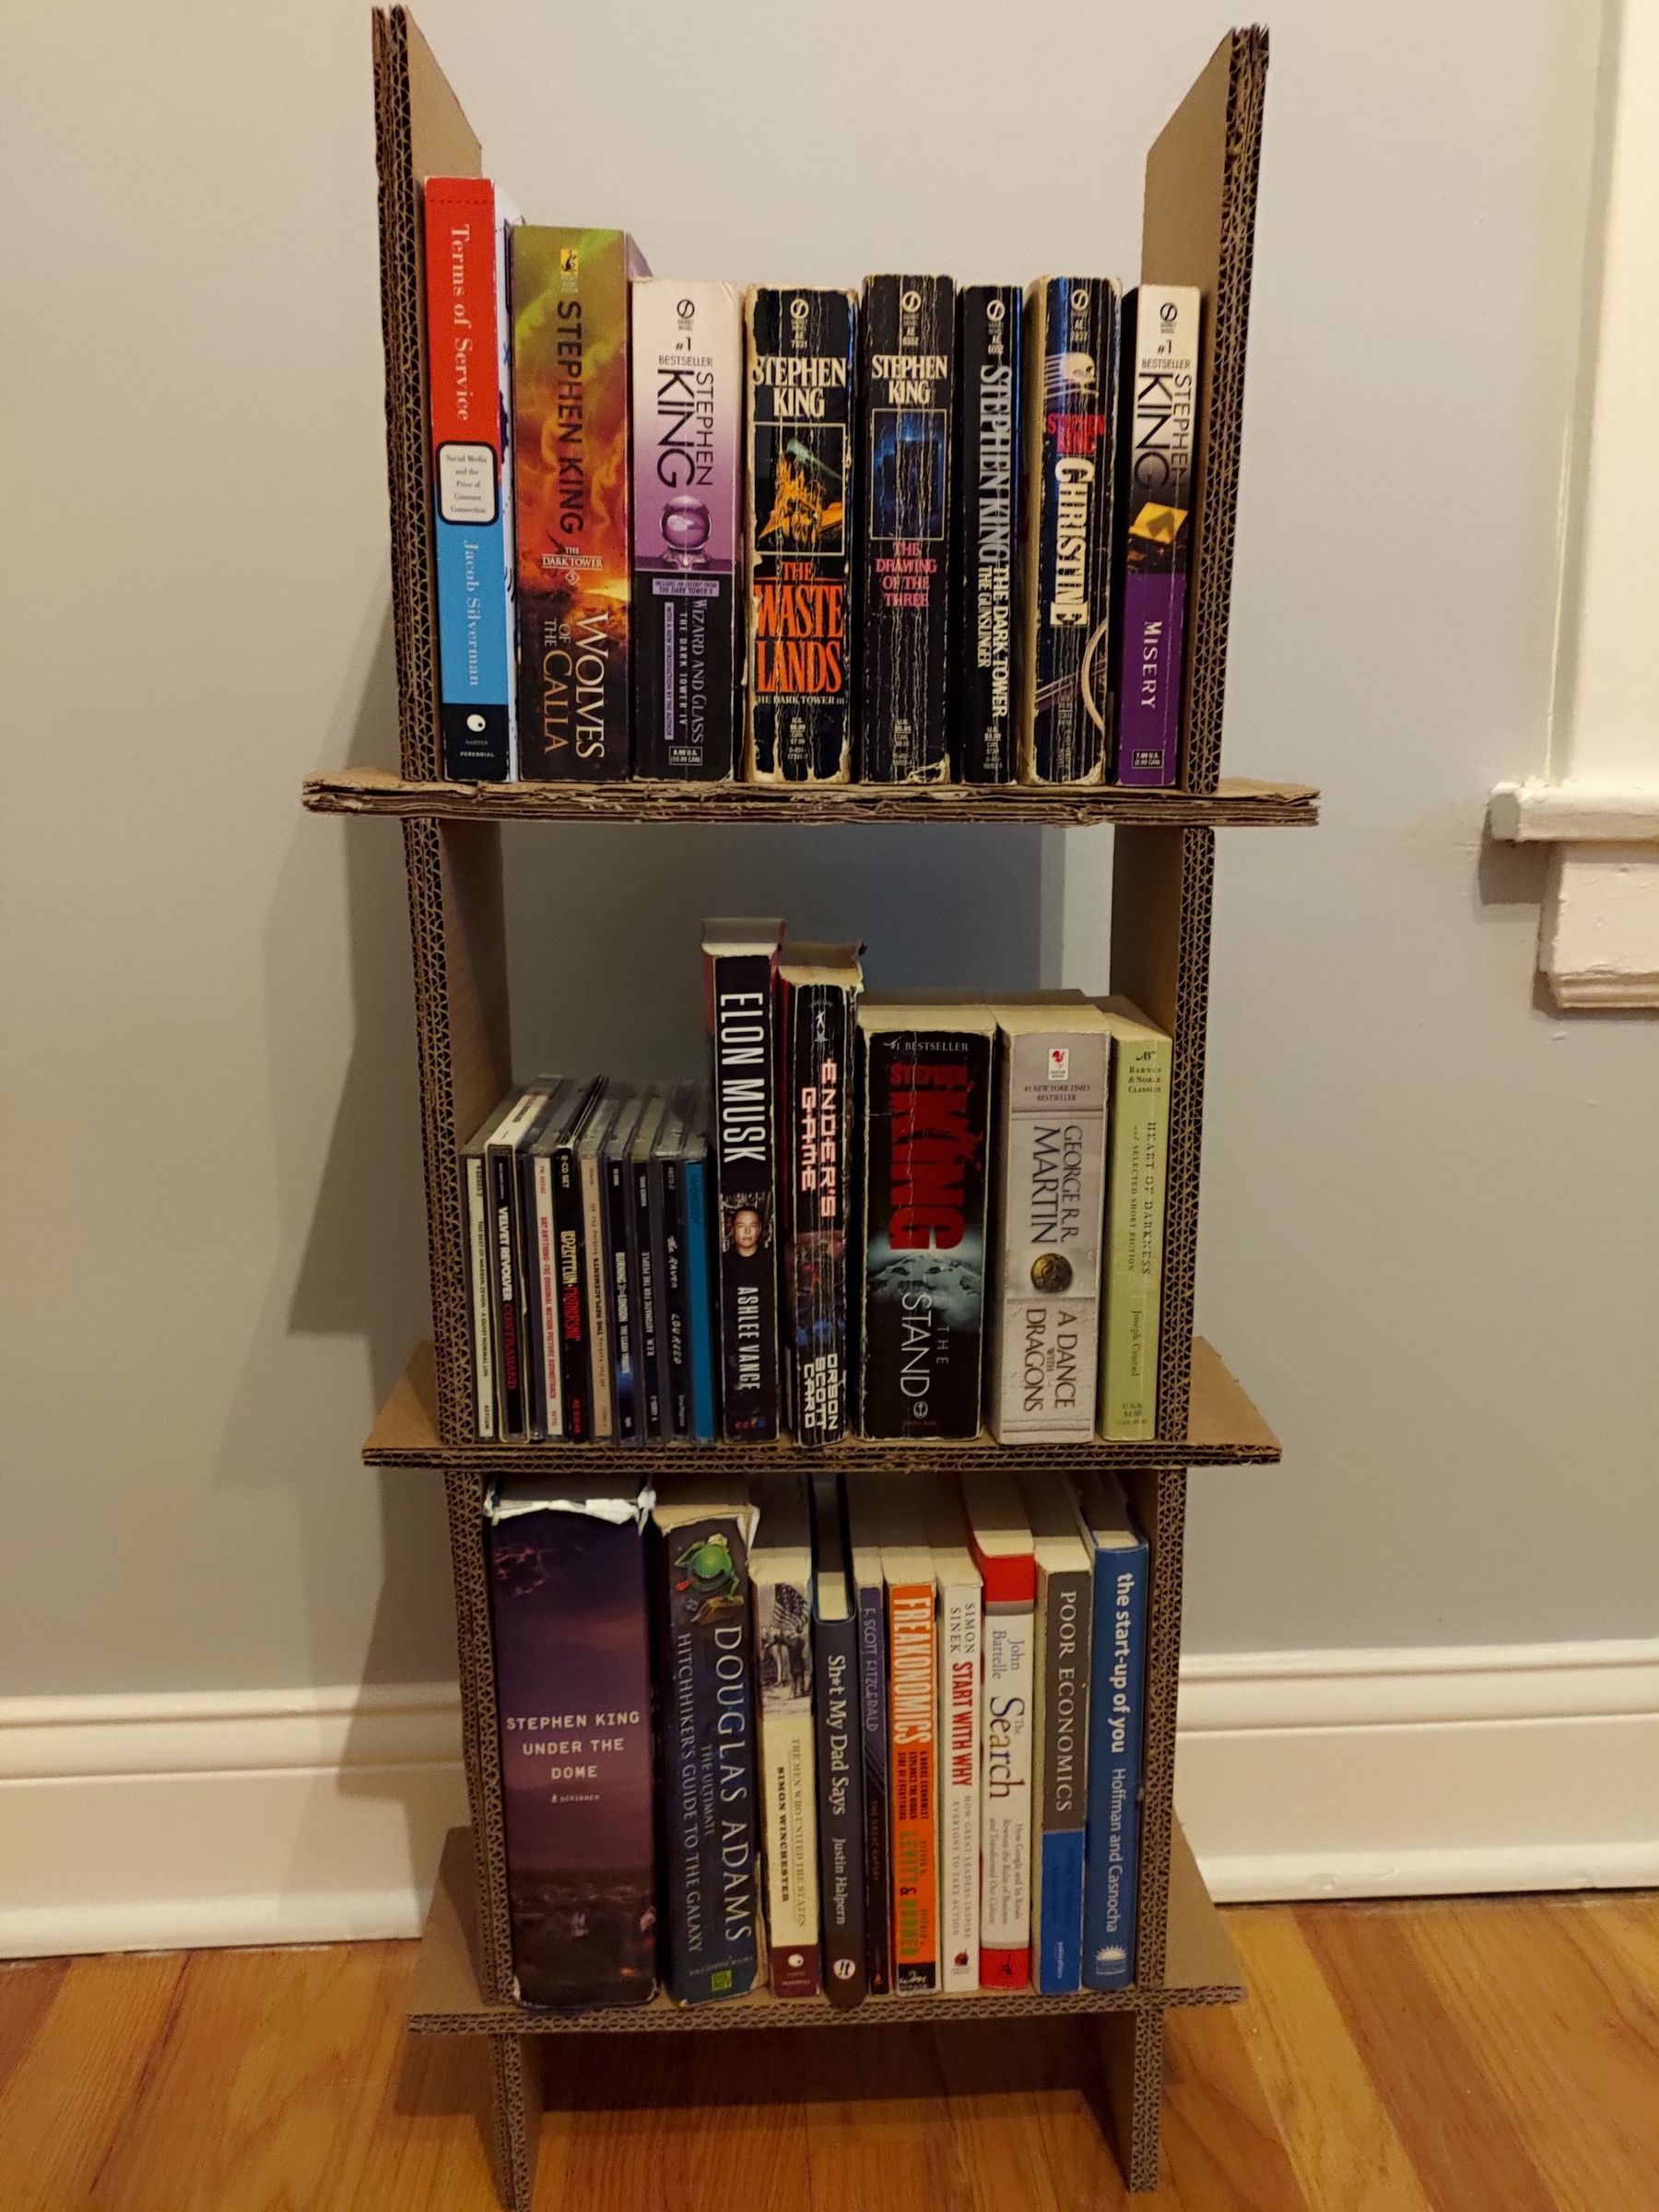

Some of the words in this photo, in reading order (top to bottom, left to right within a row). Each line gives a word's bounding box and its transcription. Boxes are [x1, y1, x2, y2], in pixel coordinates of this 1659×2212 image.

[451, 223, 470, 296] Terms
[453, 303, 472, 330] of
[658, 355, 713, 367] BESTSELLER
[676, 337, 691, 352] #1
[871, 354, 948, 380] STEPHEN
[1141, 359, 1191, 369] BESTSELLER
[1157, 339, 1171, 355] #1
[454, 337, 474, 420] Service
[557, 300, 583, 444] STEPHEN
[754, 356, 847, 388] STEPHEN
[888, 379, 931, 406] KING
[773, 387, 826, 418] KING
[656, 369, 695, 488] KING
[696, 371, 713, 486] STEPHEN
[978, 365, 1013, 491] STEPHEN
[1134, 371, 1173, 490] KING
[1171, 373, 1193, 488] STEPHEN
[559, 456, 583, 535] KING
[565, 547, 580, 555] THE
[893, 542, 922, 556] THE
[978, 495, 1011, 565] KING
[1050, 456, 1095, 628] CHRISTINE
[464, 539, 479, 592] Jacob
[542, 556, 569, 567] DARK
[569, 556, 603, 569] TOWER
[782, 561, 812, 581] THE
[875, 558, 937, 573] DRAWING
[882, 575, 900, 590] OF
[903, 575, 930, 590] THE
[978, 566, 993, 597] THE
[993, 565, 1010, 601] THE
[679, 613, 688, 633] THE
[754, 583, 845, 638] WASTE
[884, 593, 929, 607] THREE
[465, 597, 481, 687] Silverman
[544, 618, 558, 648] THE
[558, 623, 571, 644] OF
[691, 598, 707, 655] WIZARD
[977, 599, 993, 669] GUNSLINGER
[993, 605, 1009, 655] DARK
[679, 638, 688, 667] DARK
[756, 641, 842, 693] LANDS
[1140, 621, 1162, 709] MISERY
[575, 613, 608, 759] WOLVES
[679, 673, 688, 712] TOWER
[691, 664, 705, 690] AND
[992, 657, 1008, 718] TOWER
[543, 651, 573, 755] CALLA
[691, 695, 708, 744] GLASS
[720, 993, 765, 1065] ELON
[905, 1041, 969, 1052] BESTSELLER
[890, 1063, 967, 1085] STEPHEN
[1071, 1084, 1090, 1092] TIMES
[722, 1078, 766, 1163] MUSK
[801, 1087, 817, 1192] GAME
[820, 1058, 838, 1218] ENDER'S
[1062, 1124, 1083, 1202] GEORGE
[1146, 1122, 1157, 1169] HEART
[888, 1091, 968, 1250] KING
[1030, 1126, 1061, 1244] MARTIN
[1131, 1144, 1140, 1194] SELECTED
[498, 1206, 510, 1246] VELVET
[1129, 1198, 1137, 1230] SHORT
[1128, 1231, 1136, 1271] FICTION
[1141, 1201, 1154, 1275] DARKNESS
[499, 1246, 513, 1301] REVOLVER
[671, 1313, 682, 1335] LOU
[737, 1287, 759, 1339] ASHLEE
[1057, 1310, 1077, 1326] A
[1130, 1311, 1142, 1341] Joseph
[501, 1303, 517, 1390] CONTRABAND
[671, 1335, 682, 1365] REED
[900, 1292, 933, 1397] STAND
[935, 1325, 949, 1364] THE
[1023, 1309, 1046, 1412] DRAGONS
[1046, 1347, 1055, 1372] WITH
[1130, 1344, 1140, 1377] Conrad
[738, 1345, 760, 1391] VANCE
[1054, 1334, 1078, 1408] DANCE
[804, 1363, 816, 1429] CARD
[815, 1357, 827, 1430] SCOTT
[827, 1353, 839, 1430] ORSON
[1116, 1572, 1135, 1606] the
[863, 1619, 877, 1654] SCOTT
[949, 1606, 961, 1653] SINEK
[964, 1603, 975, 1653] SIMON
[1059, 1591, 1077, 1659] POOR
[893, 1597, 932, 1745] FREAKONOMICS
[1007, 1639, 1025, 1671] John
[1109, 1610, 1132, 1689] start-up
[677, 1633, 696, 1760] HITCHHIKER'S
[865, 1660, 878, 1732] FITZGERALD
[952, 1662, 972, 1707] START
[1112, 1696, 1131, 1712] of
[506, 1713, 587, 1730] STEPHEN
[595, 1711, 641, 1726] KING
[714, 1624, 747, 1803] DOUGLAS
[826, 1700, 847, 1730] My
[951, 1710, 972, 1748] WITH
[1015, 1720, 1024, 1735] The
[1108, 1718, 1126, 1753] you
[523, 1740, 582, 1755] UNDER
[590, 1738, 625, 1752] THE
[700, 1743, 712, 1769] THE
[830, 1734, 850, 1771] Dad
[990, 1696, 1026, 1798] Search
[1056, 1667, 1075, 1812] ECONOMICS
[551, 1765, 598, 1780] DOME
[777, 1767, 786, 1811] SIMON
[952, 1752, 973, 1786] WHY
[681, 1764, 698, 1821] GUIDE
[701, 1773, 715, 1837] ULTIMATE
[829, 1776, 850, 1816] Says
[1110, 1768, 1127, 1831] Hoffman
[684, 1824, 699, 1849] TO
[780, 1813, 790, 1902] WINCHESTER
[832, 1838, 847, 1874] Justin
[1109, 1835, 1124, 1862] and
[685, 1852, 700, 1886] THE
[721, 1819, 752, 1942] ADAMS
[687, 1889, 702, 1952] GALAXY
[796, 1885, 806, 1926] STATES
[833, 1877, 848, 1925] Halpern
[1107, 1865, 1124, 1933] Casnocha
